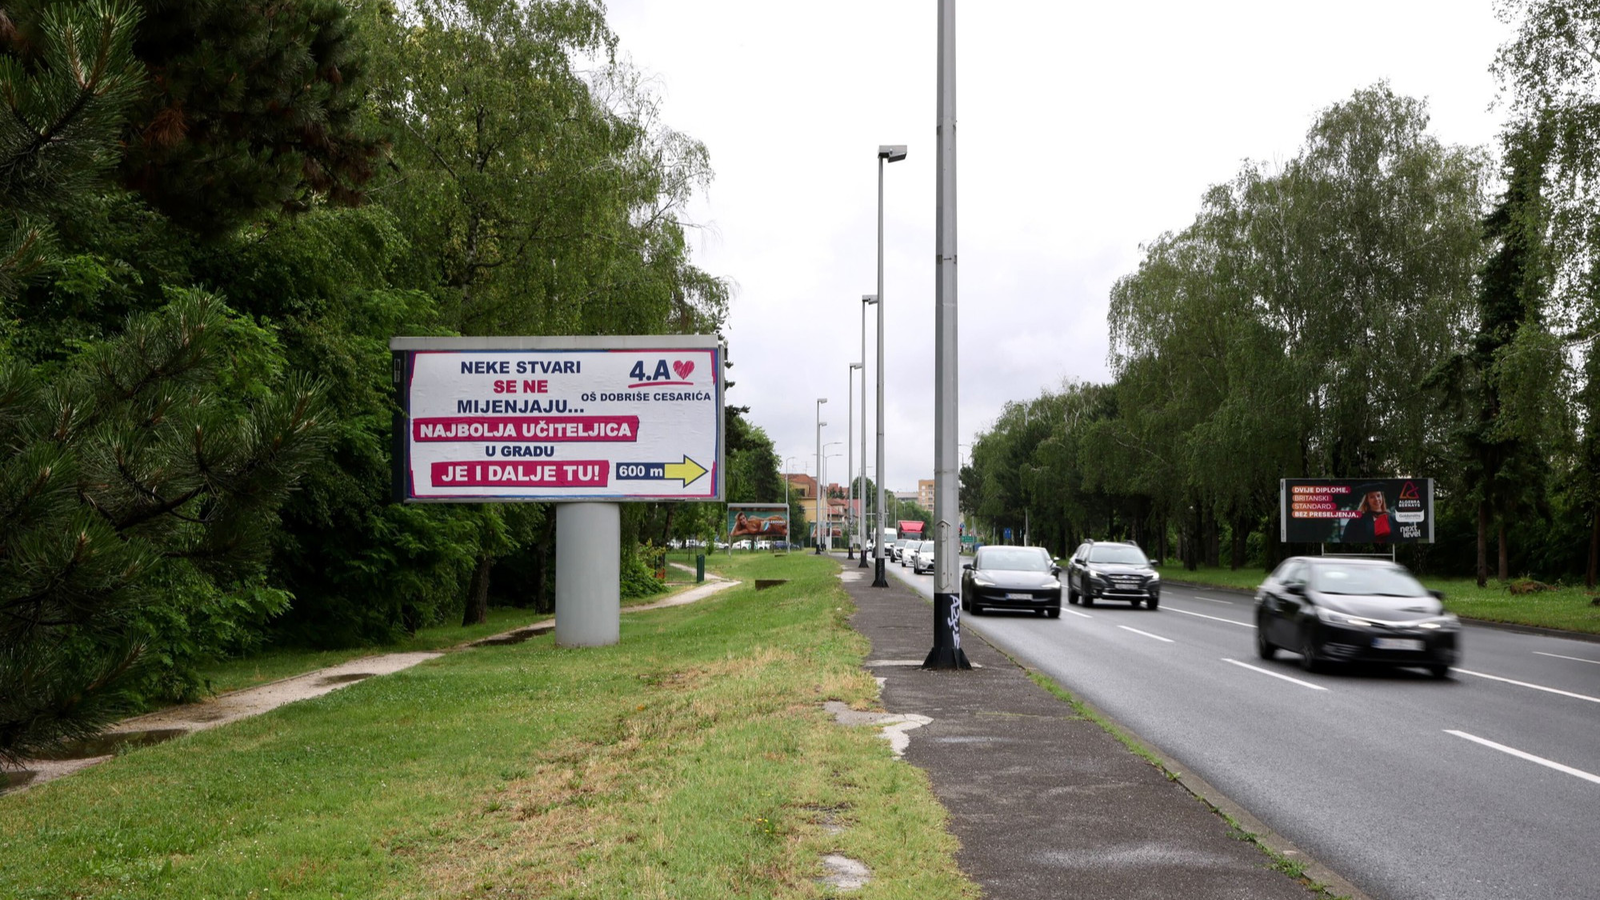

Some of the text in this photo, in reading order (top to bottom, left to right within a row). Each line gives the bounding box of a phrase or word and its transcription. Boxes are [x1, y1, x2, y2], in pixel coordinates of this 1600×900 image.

[461, 361, 581, 374] NEKE STVARI
[629, 359, 671, 381] 4.A
[493, 380, 548, 394] SE NE
[581, 390, 711, 402] OŠ DOBRIŠE CESARIĆA
[457, 399, 584, 413] MIJENJAJU...
[420, 420, 632, 438] NAJBOLJA UČITELJICA
[485, 445, 554, 457] U GRADU
[441, 465, 600, 482] JE I DALJE TU!
[618, 465, 664, 477] 600 m
[1400, 521, 1418, 533] next
[1402, 530, 1421, 538] level
